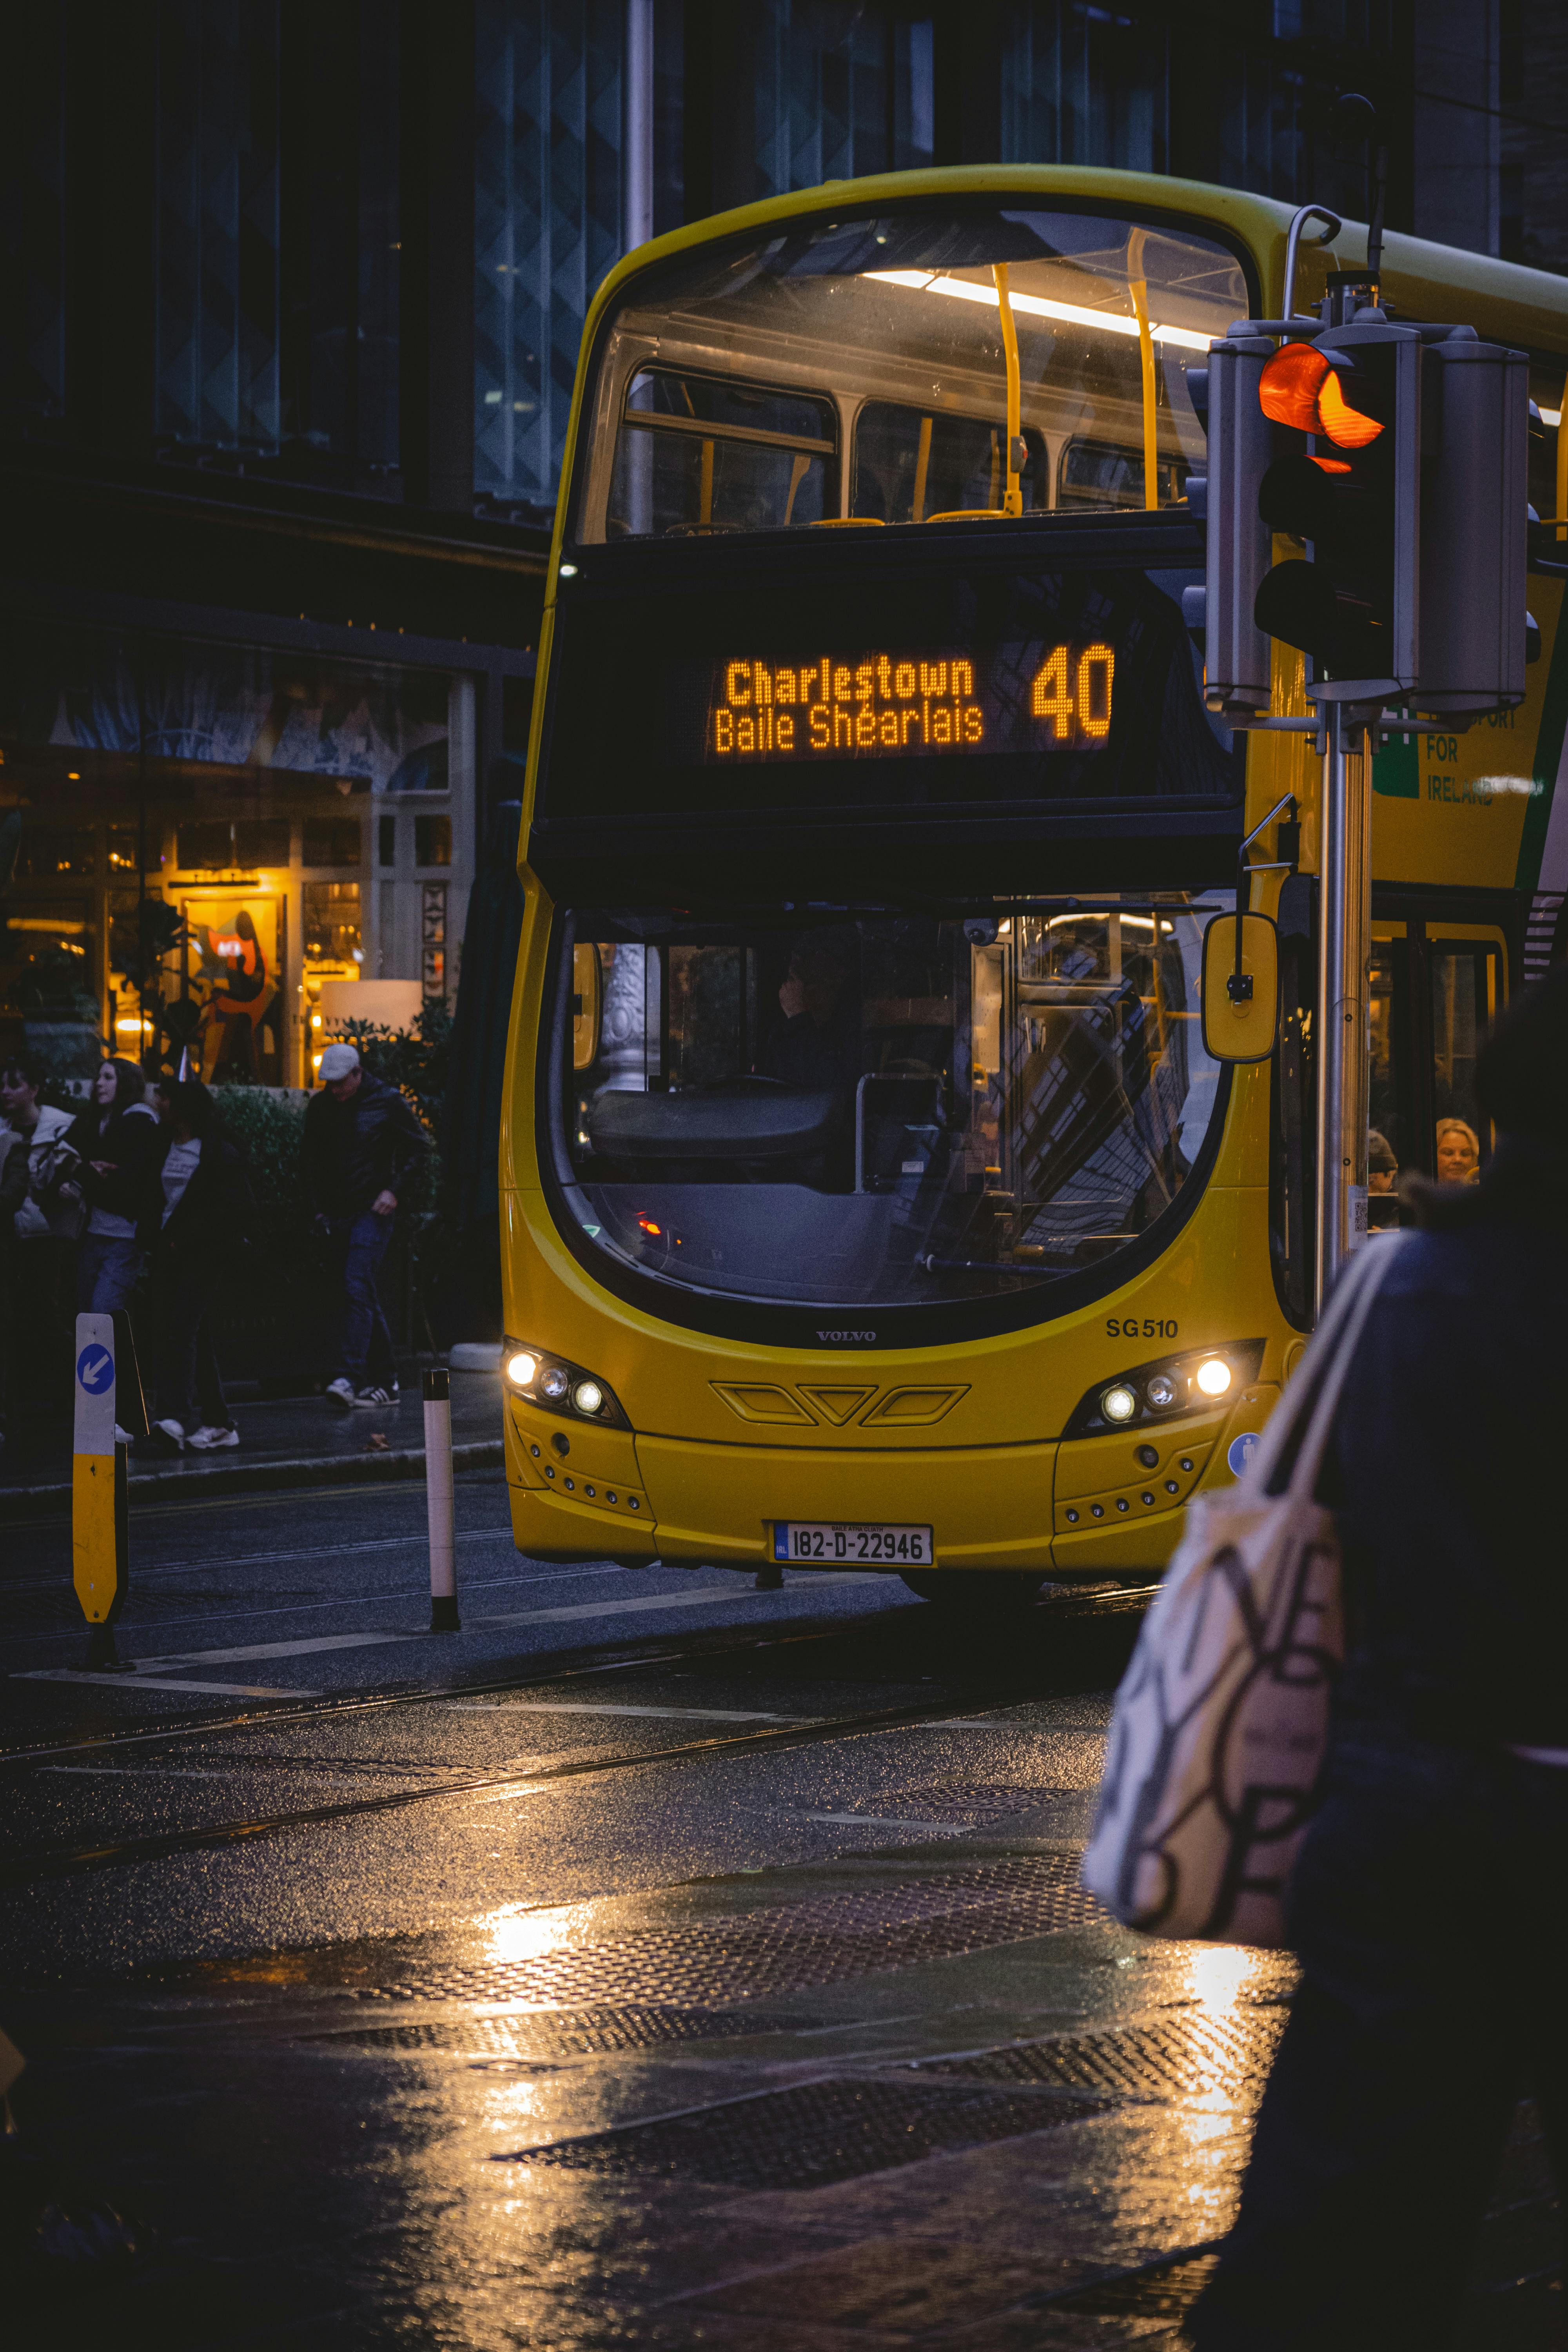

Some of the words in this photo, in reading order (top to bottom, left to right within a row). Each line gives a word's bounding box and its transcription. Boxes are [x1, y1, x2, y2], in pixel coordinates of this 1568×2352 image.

[728, 656, 973, 706] Charlestown
[1032, 644, 1115, 739] 40
[715, 708, 794, 752] Baile
[809, 699, 983, 748] Shéarlais
[1426, 734, 1458, 762] FOR
[1428, 775, 1493, 806] IRELAND
[816, 1331, 876, 1341] VOLVO
[1107, 1319, 1178, 1338] SG510
[794, 1531, 922, 1559] 182-D-22946
